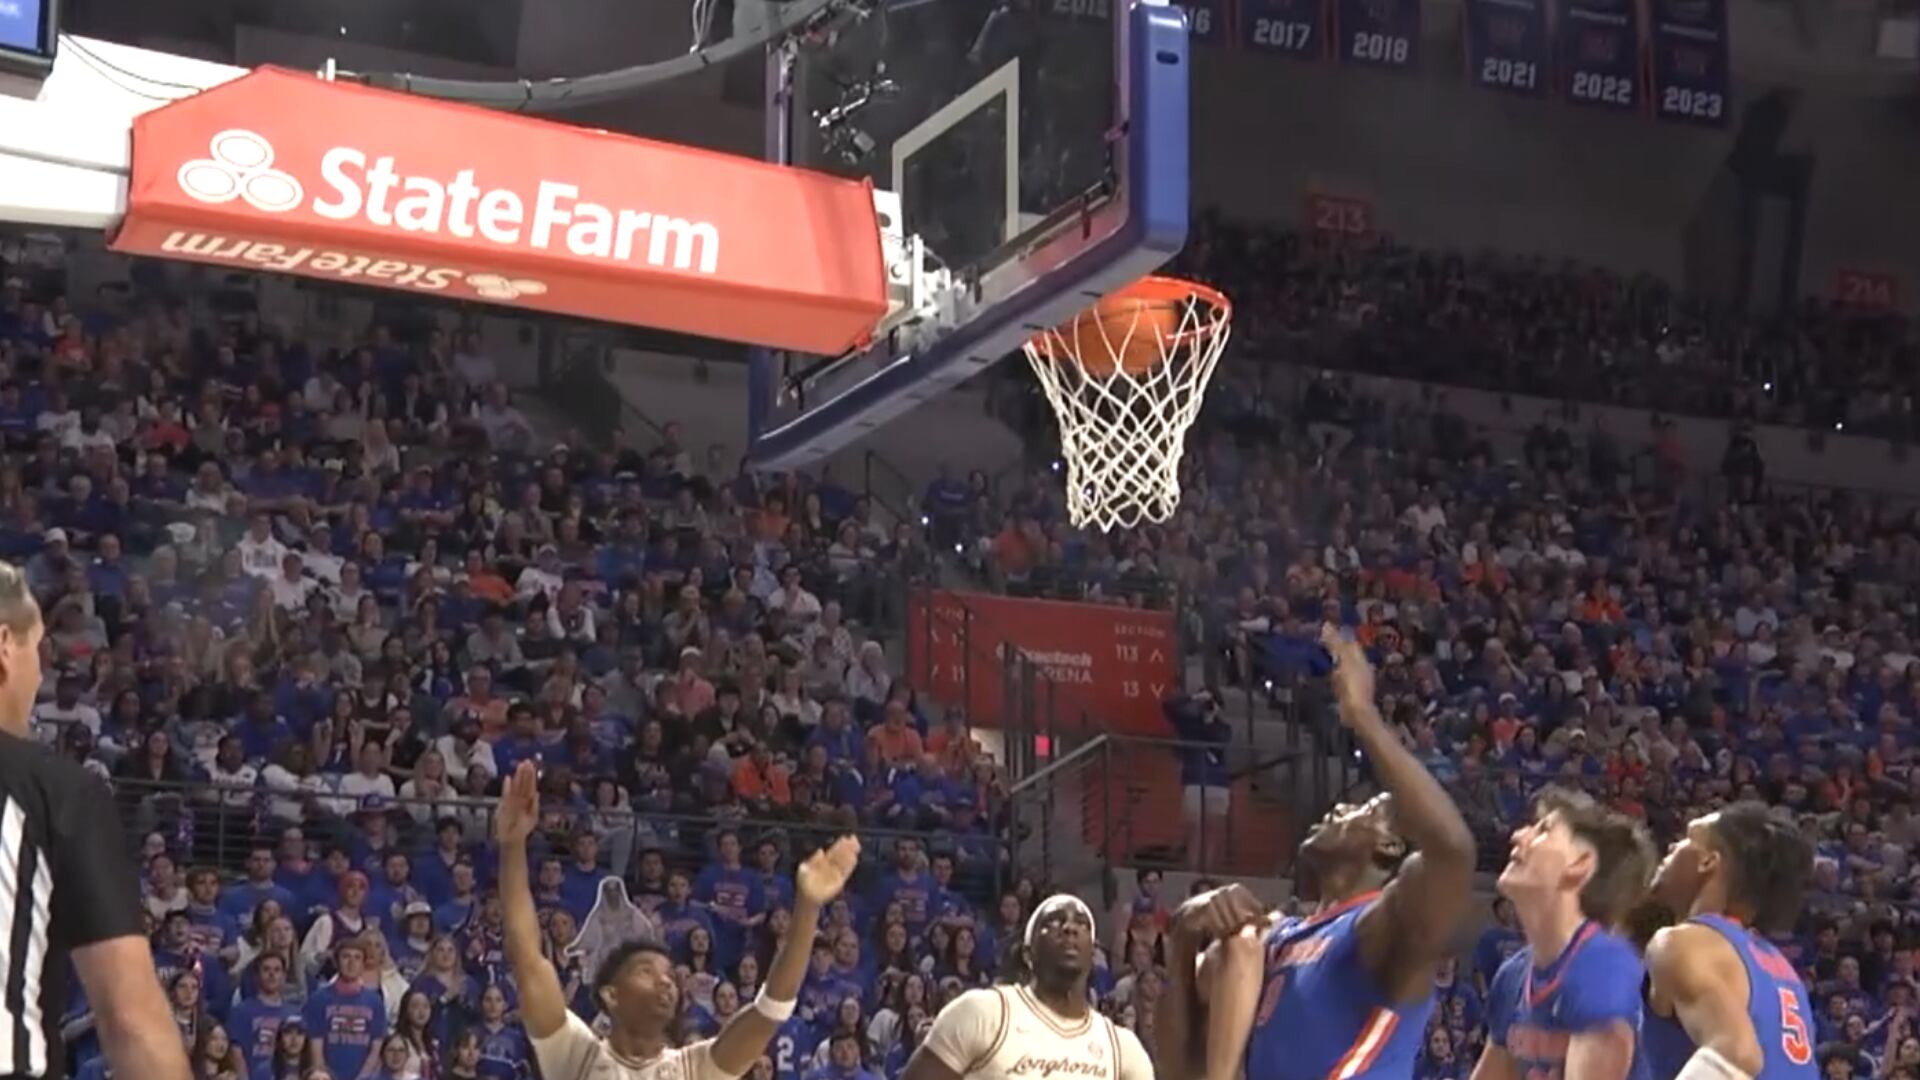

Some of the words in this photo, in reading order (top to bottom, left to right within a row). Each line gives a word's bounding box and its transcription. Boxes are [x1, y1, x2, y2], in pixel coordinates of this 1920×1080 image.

[1253, 18, 1311, 50] 2017
[1352, 32, 1409, 63] 2018
[1482, 57, 1537, 89] 2021
[1572, 71, 1632, 104] 2022
[1663, 86, 1723, 118] 2023
[1315, 200, 1366, 234] 213
[1116, 643, 1139, 663] 113
[1035, 665, 1094, 684] RENA
[1122, 680, 1140, 697] 13
[1778, 987, 1812, 1065] 5
[777, 1035, 795, 1072] 2
[1005, 1054, 1108, 1078] Longhorns
